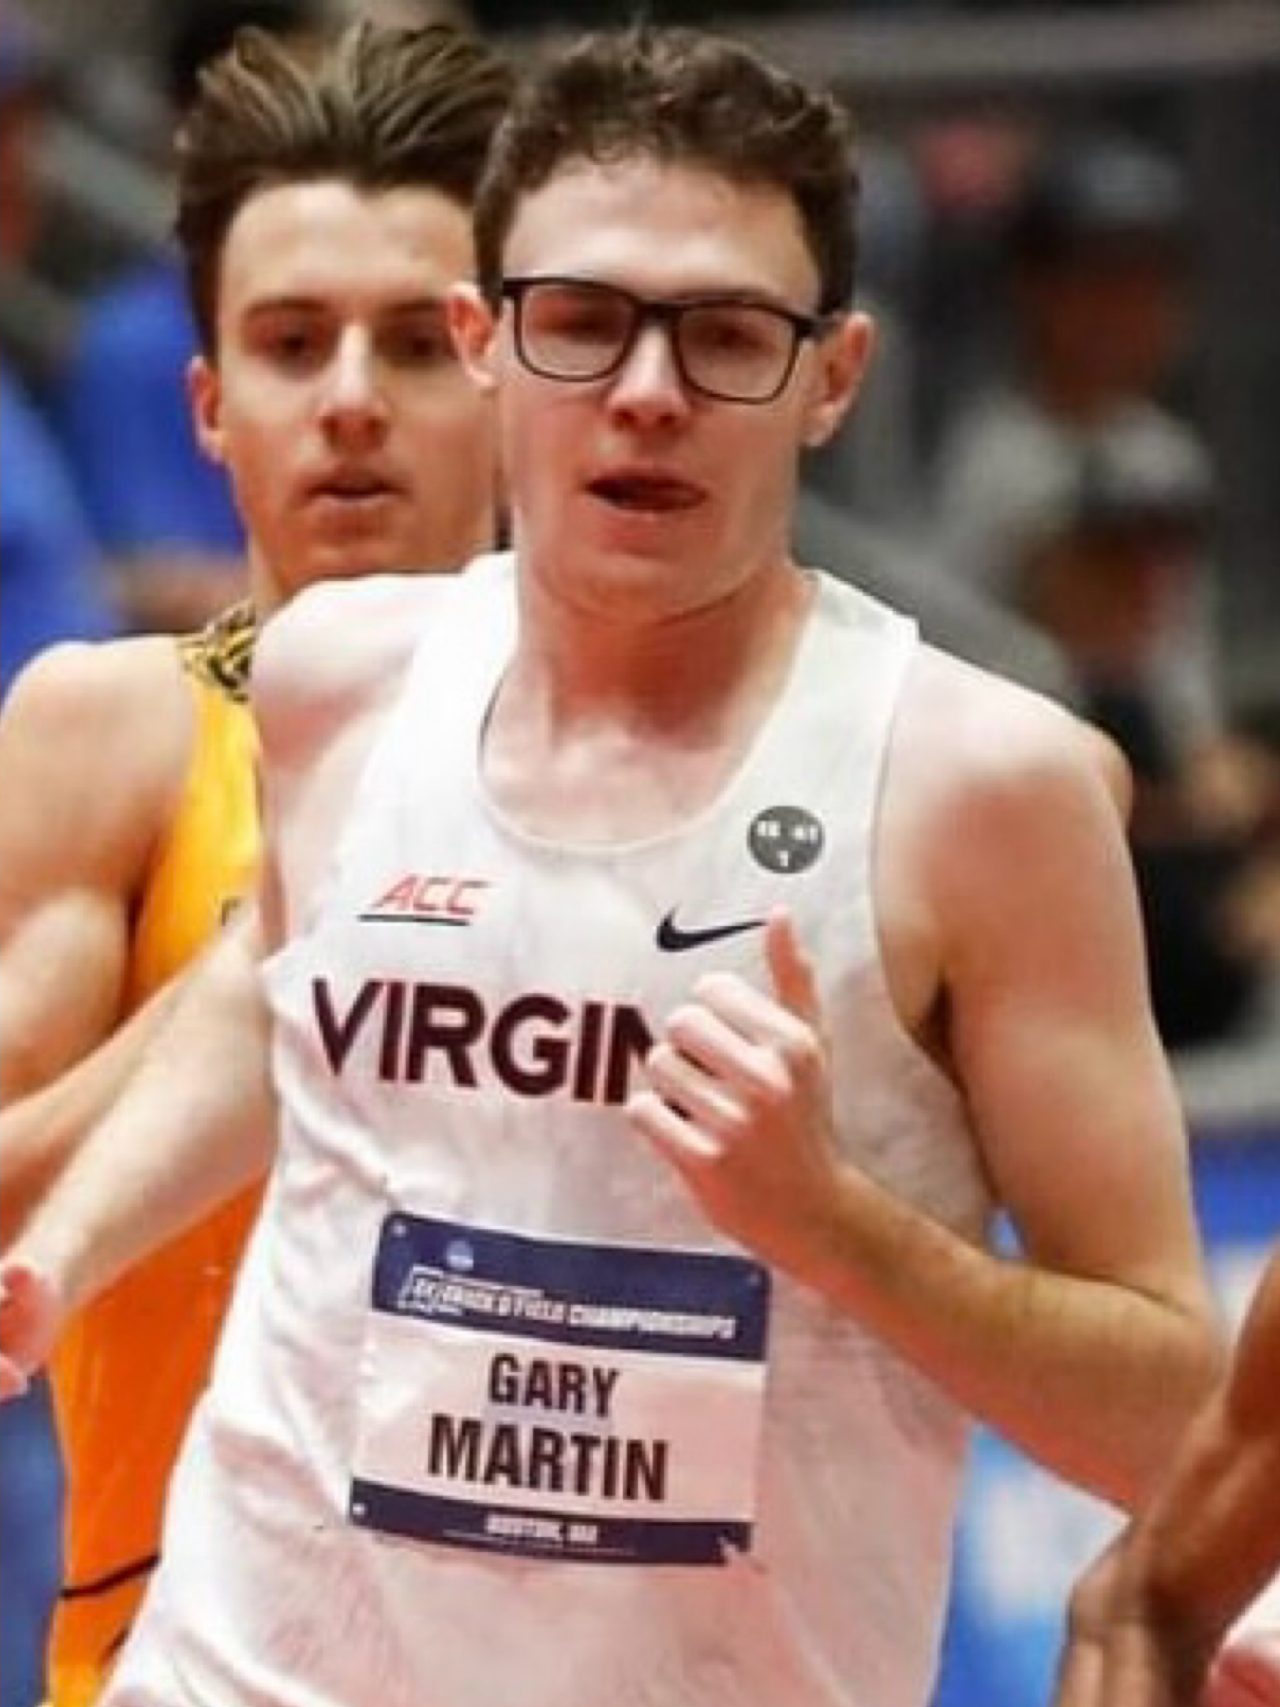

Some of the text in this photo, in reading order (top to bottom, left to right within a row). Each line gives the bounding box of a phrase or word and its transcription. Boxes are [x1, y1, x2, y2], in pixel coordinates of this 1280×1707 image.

[371, 873, 491, 917] ACC
[487, 1352, 620, 1418] GARY
[427, 1412, 670, 1503] MARTIN
